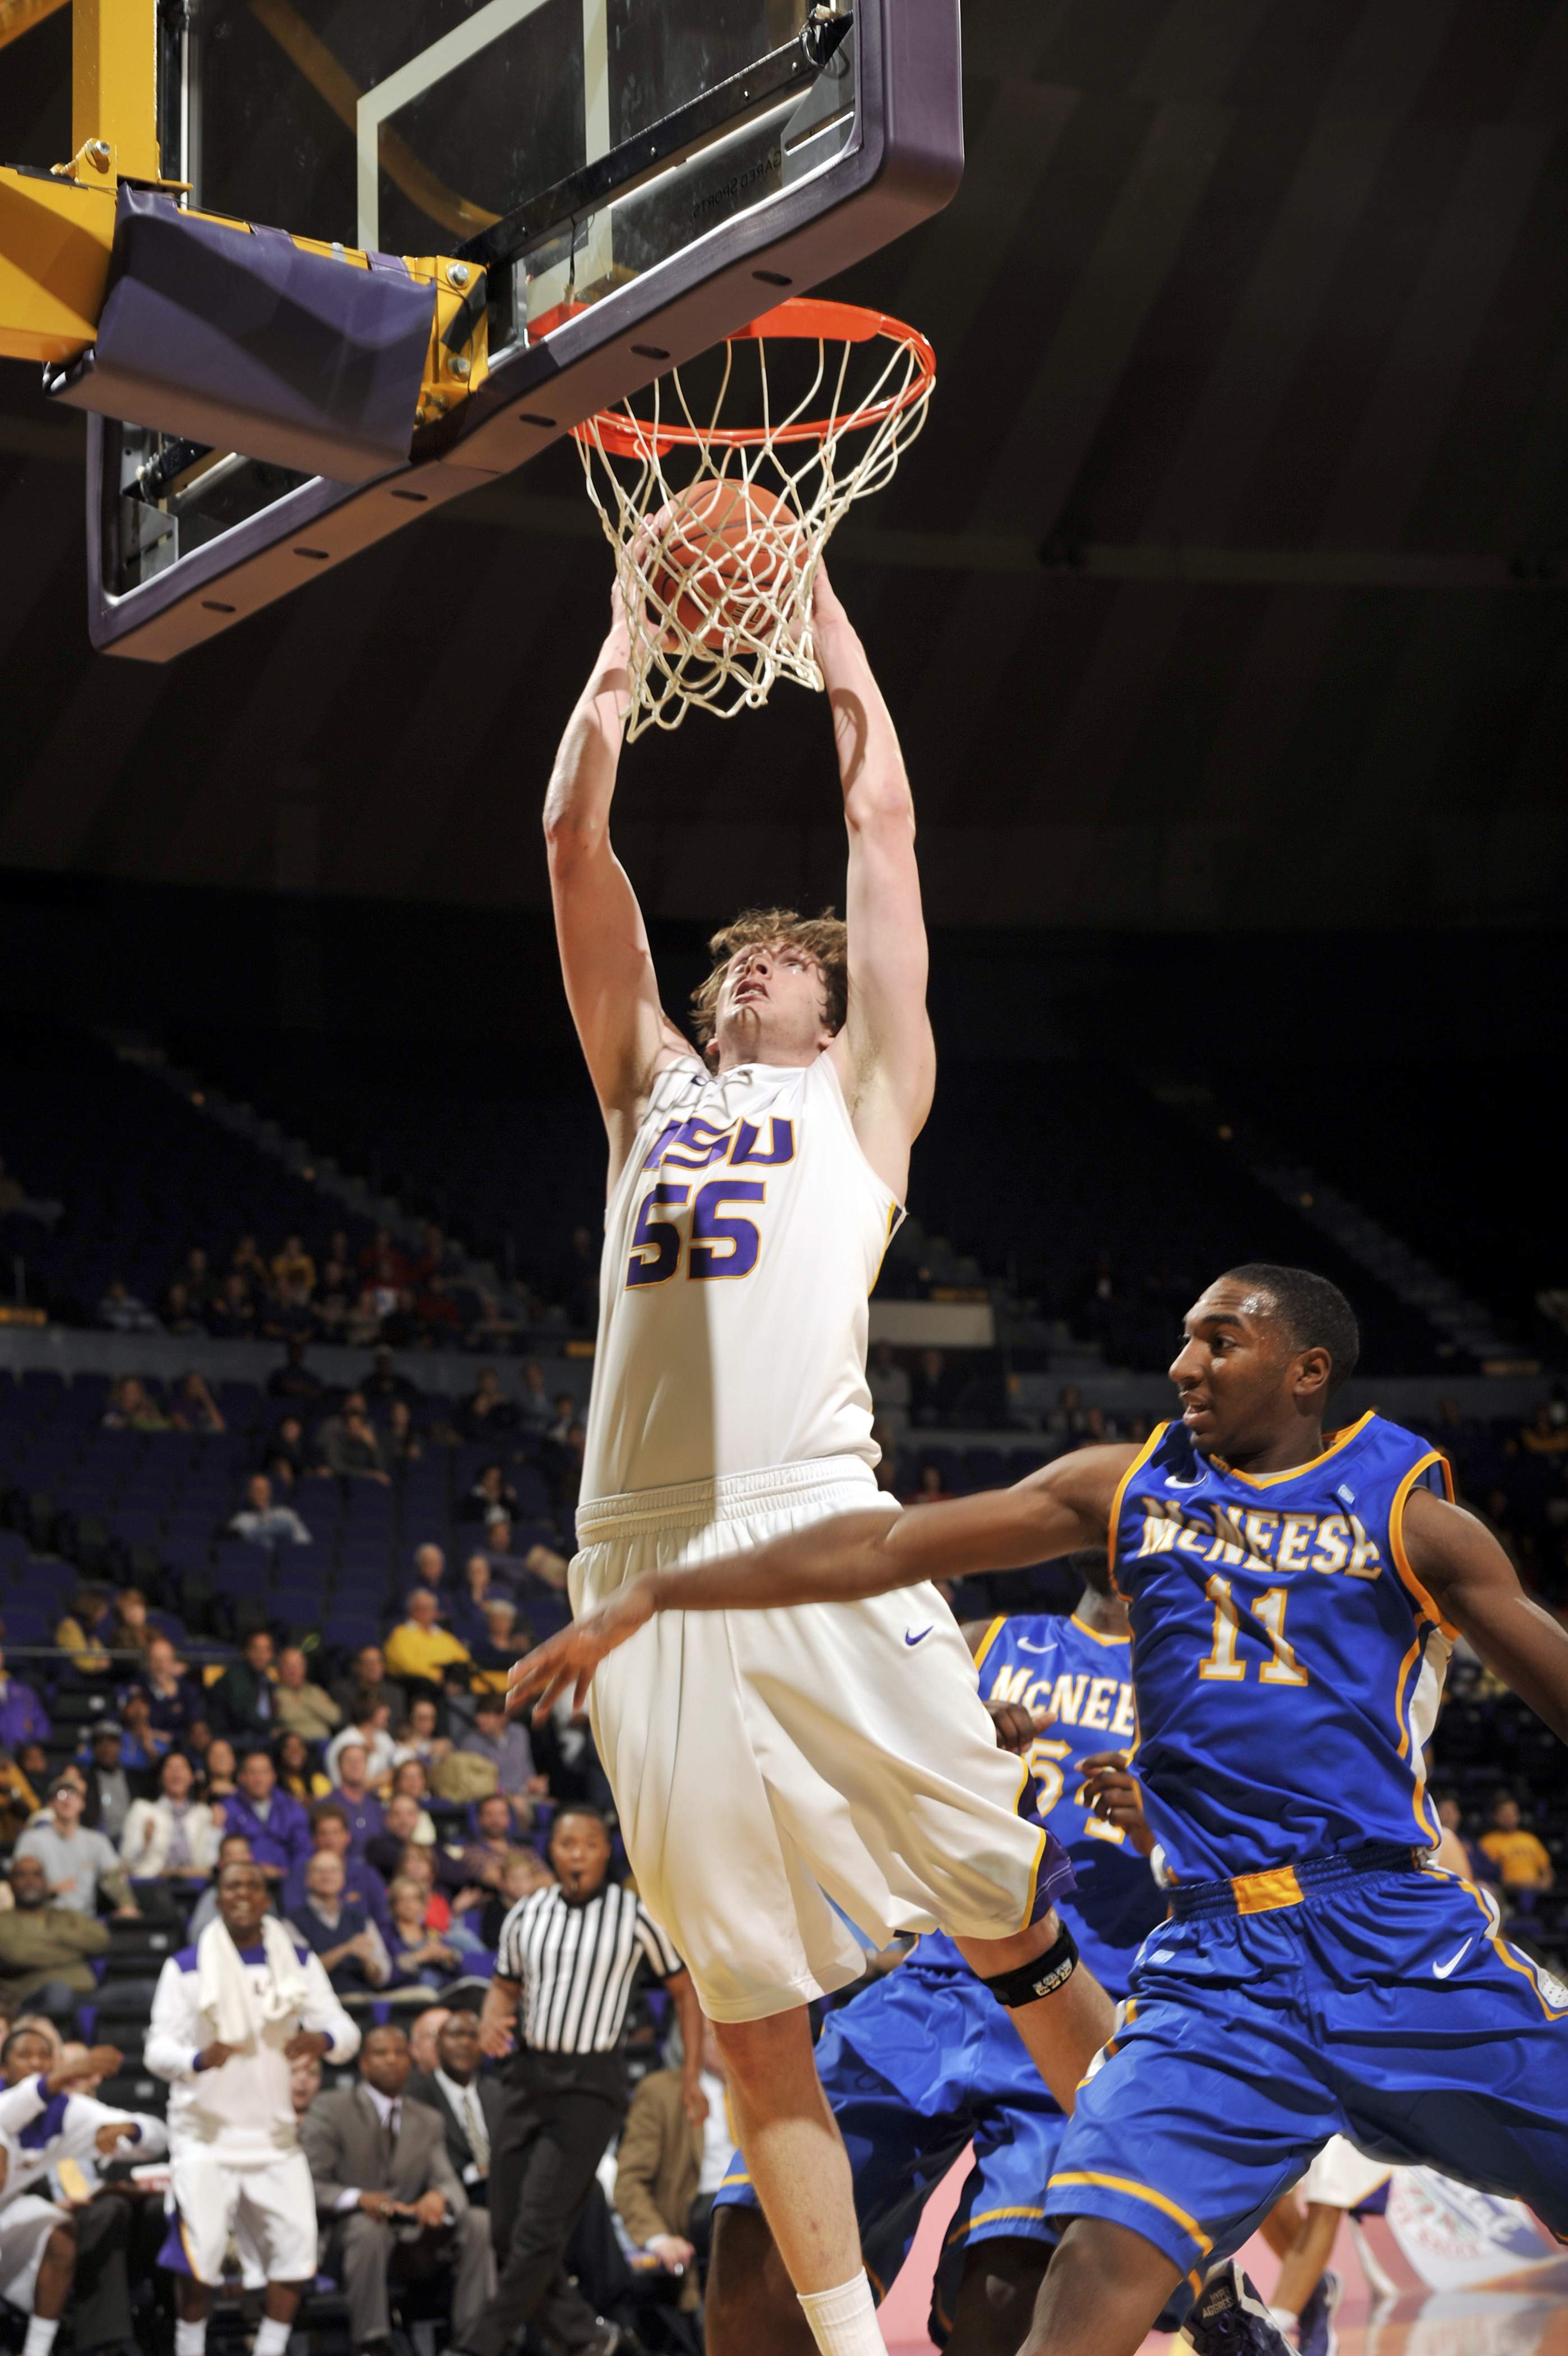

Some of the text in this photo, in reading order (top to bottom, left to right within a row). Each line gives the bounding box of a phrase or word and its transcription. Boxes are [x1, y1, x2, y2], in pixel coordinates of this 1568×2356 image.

[641, 1115, 796, 1172] LSU
[624, 1179, 766, 1290] 55
[1198, 1573, 1309, 1687] 11
